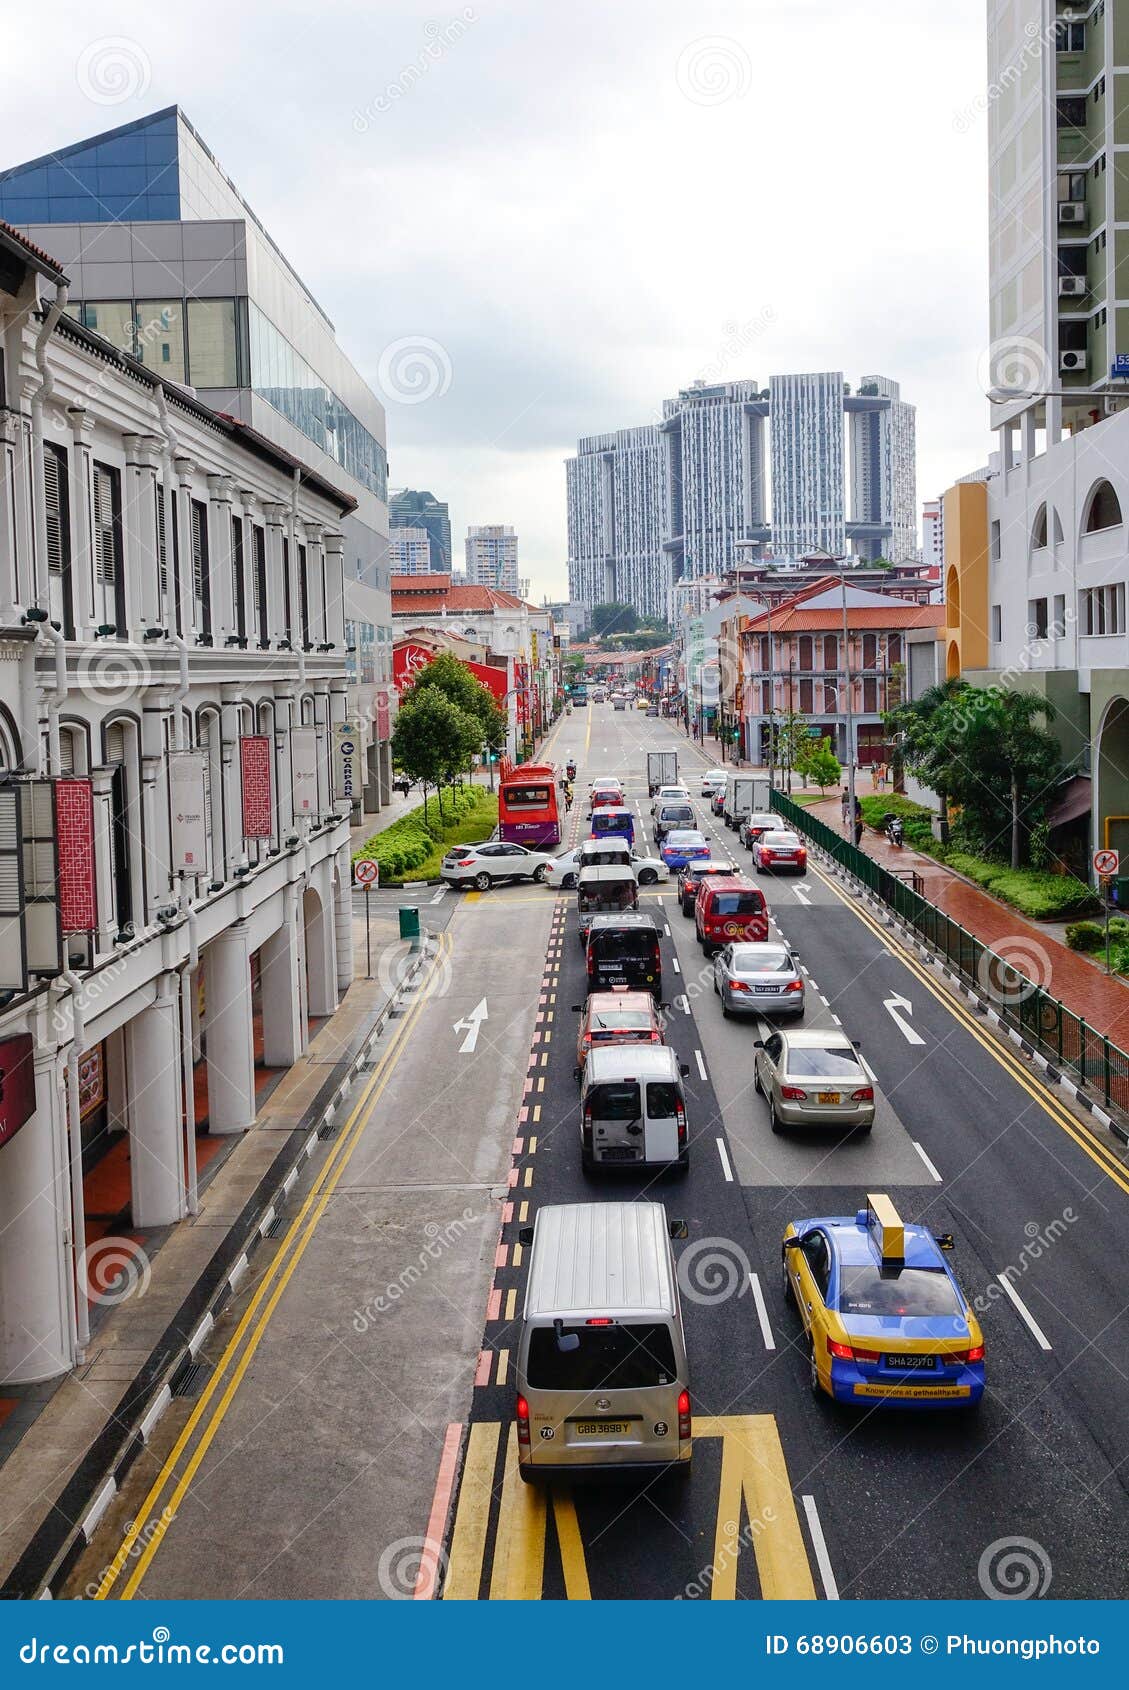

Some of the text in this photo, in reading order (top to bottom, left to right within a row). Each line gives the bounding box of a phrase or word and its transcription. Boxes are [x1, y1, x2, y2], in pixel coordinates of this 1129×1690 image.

[343, 757, 353, 797] CARPARK
[865, 1387, 885, 1395] Know
[541, 1428, 553, 1436] 70
